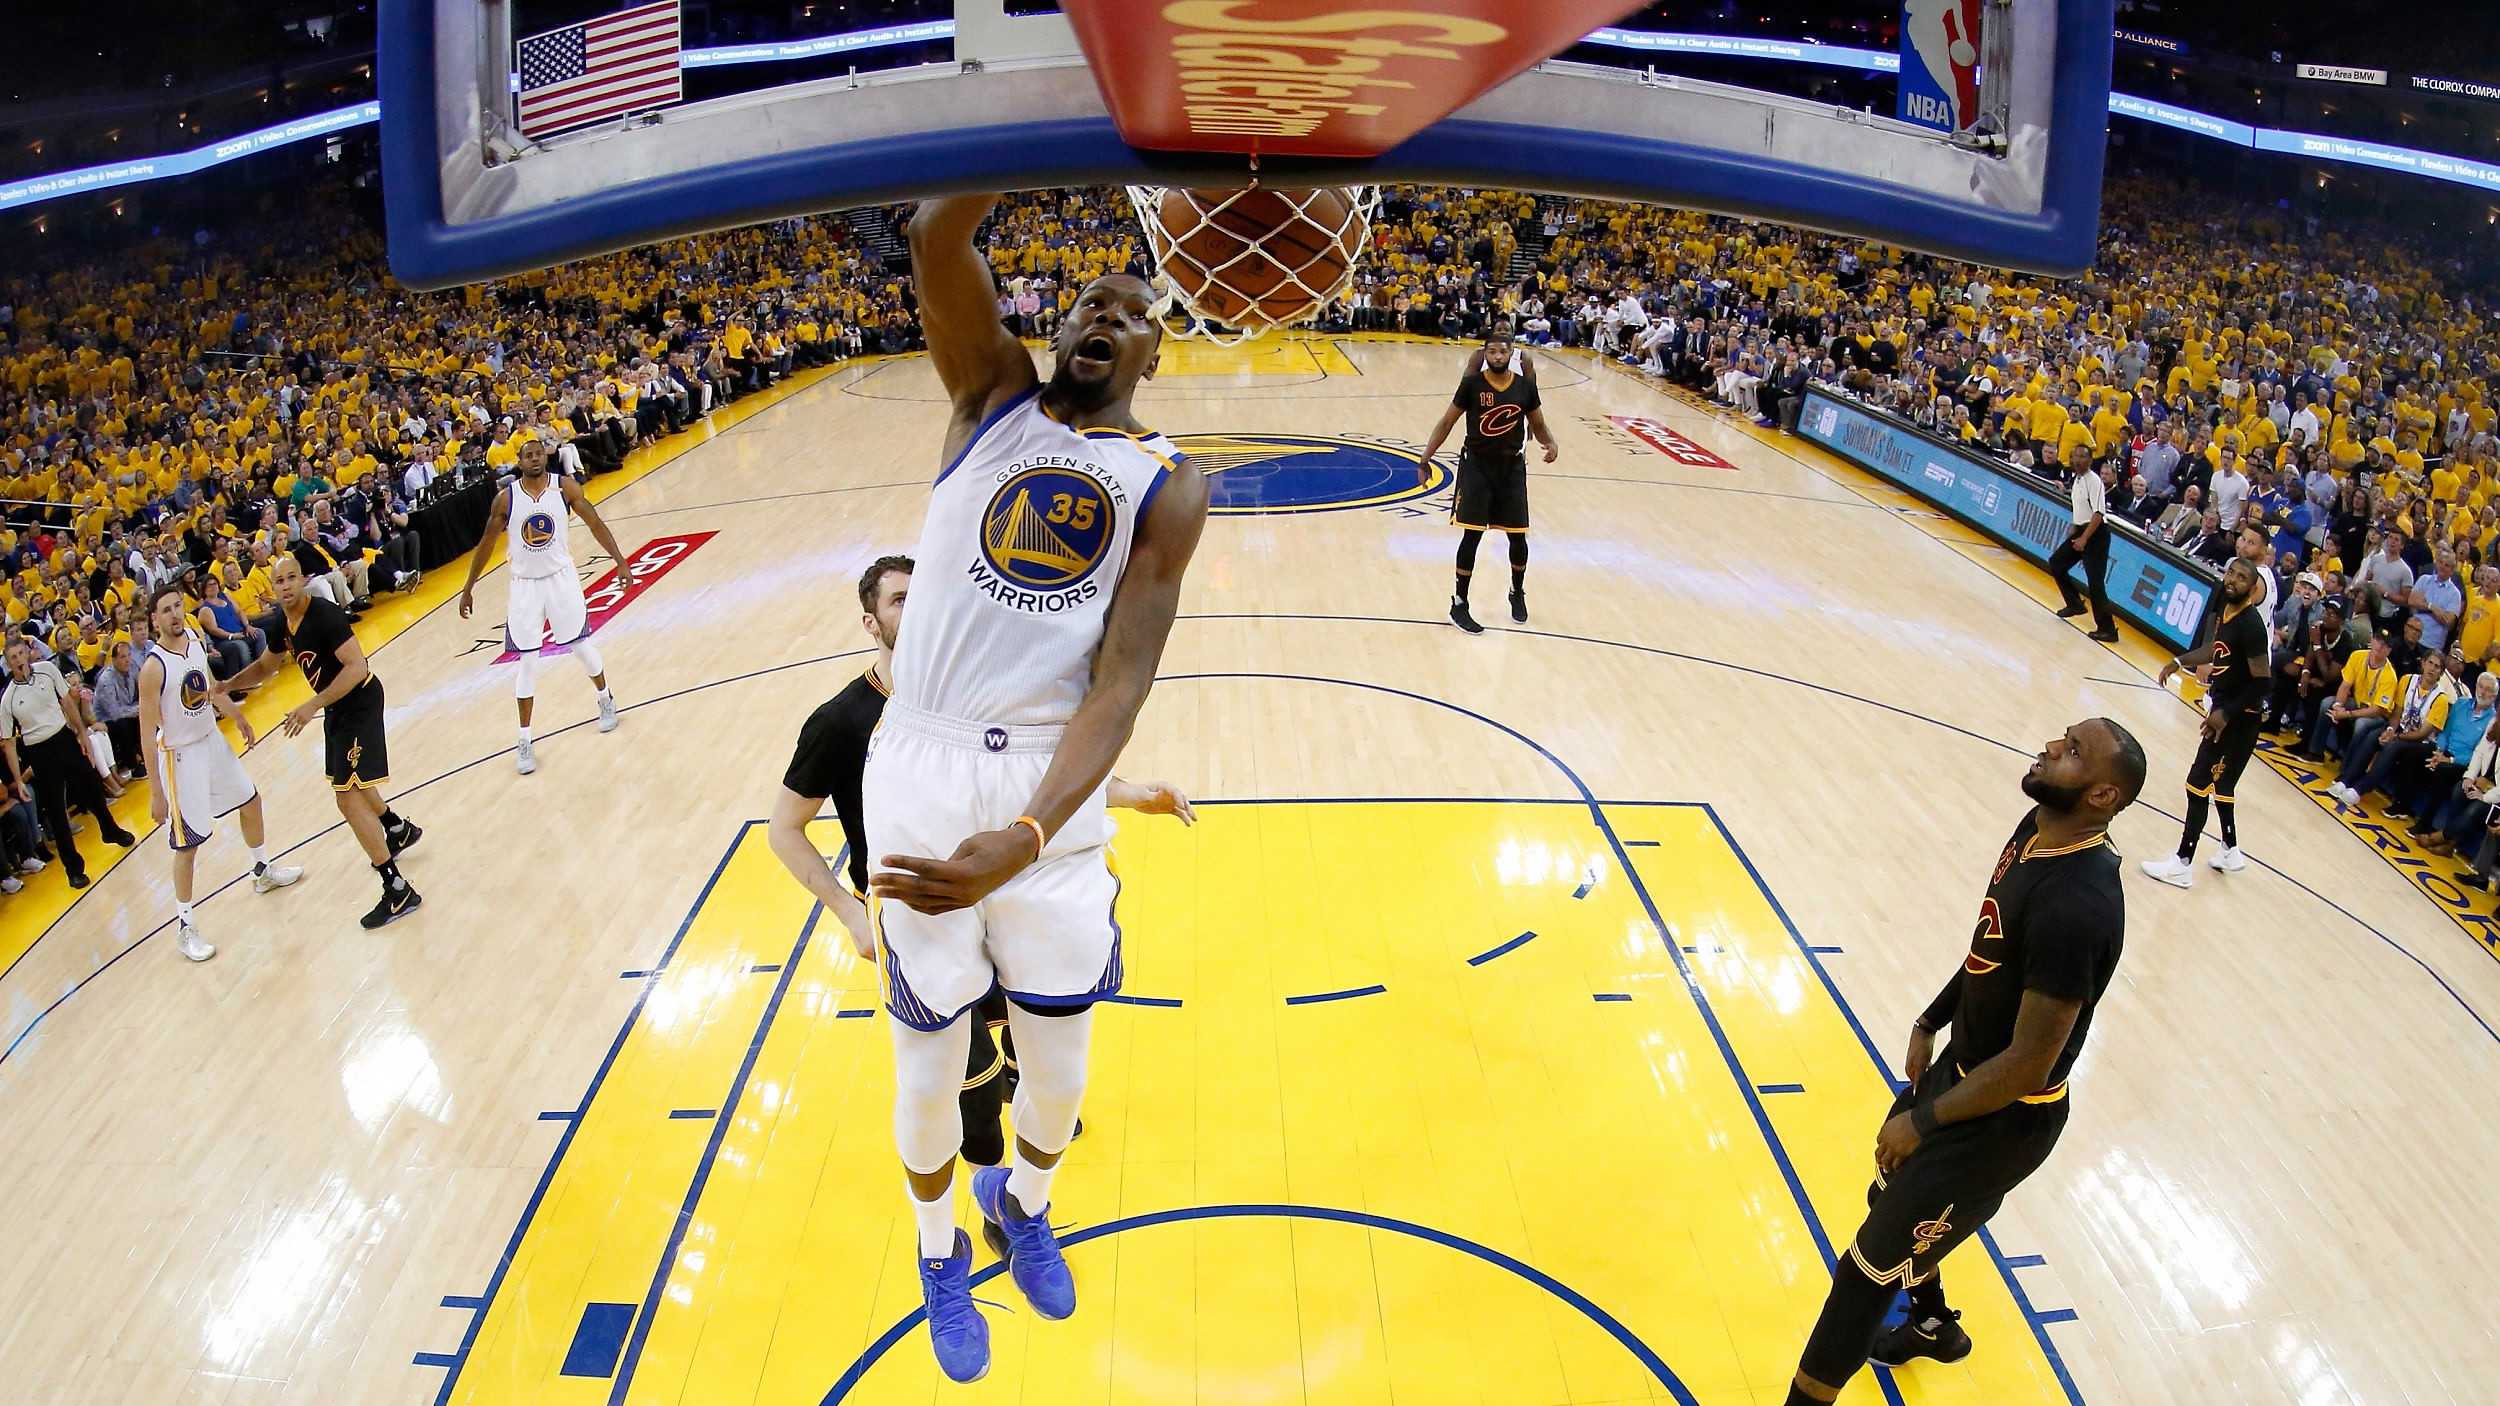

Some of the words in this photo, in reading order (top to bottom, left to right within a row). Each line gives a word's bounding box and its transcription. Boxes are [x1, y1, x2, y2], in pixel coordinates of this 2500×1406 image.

[1162, 0, 1508, 98] State
[2124, 33, 2177, 51] ALLIANCE
[2318, 68, 2333, 79] Bay
[2334, 70, 2352, 79] Area
[2353, 71, 2375, 81] BMW
[2411, 76, 2429, 89] THE
[2429, 79, 2464, 93] CLOROX
[1184, 95, 1388, 137] Farm
[1907, 93, 1950, 126] NBA
[2118, 99, 2146, 114] Audio
[2156, 107, 2190, 124] Instant
[2190, 116, 2225, 135] Sharing
[216, 141, 251, 158] zoom
[259, 131, 285, 145] Video
[285, 112, 359, 138] Communications
[2303, 139, 2331, 152] zoom
[2454, 164, 2478, 178] Video
[0, 188, 28, 201] lawless
[1480, 392, 1494, 407] 13
[1624, 419, 1718, 465] ORACLE
[996, 456, 1078, 483] GOLDEN
[1082, 463, 1128, 507] STATE
[538, 519, 545, 529] 9
[1046, 492, 1098, 531] 35
[967, 557, 1098, 613] WARRIORS
[192, 675, 201, 689] 11
[988, 733, 1006, 747] W
